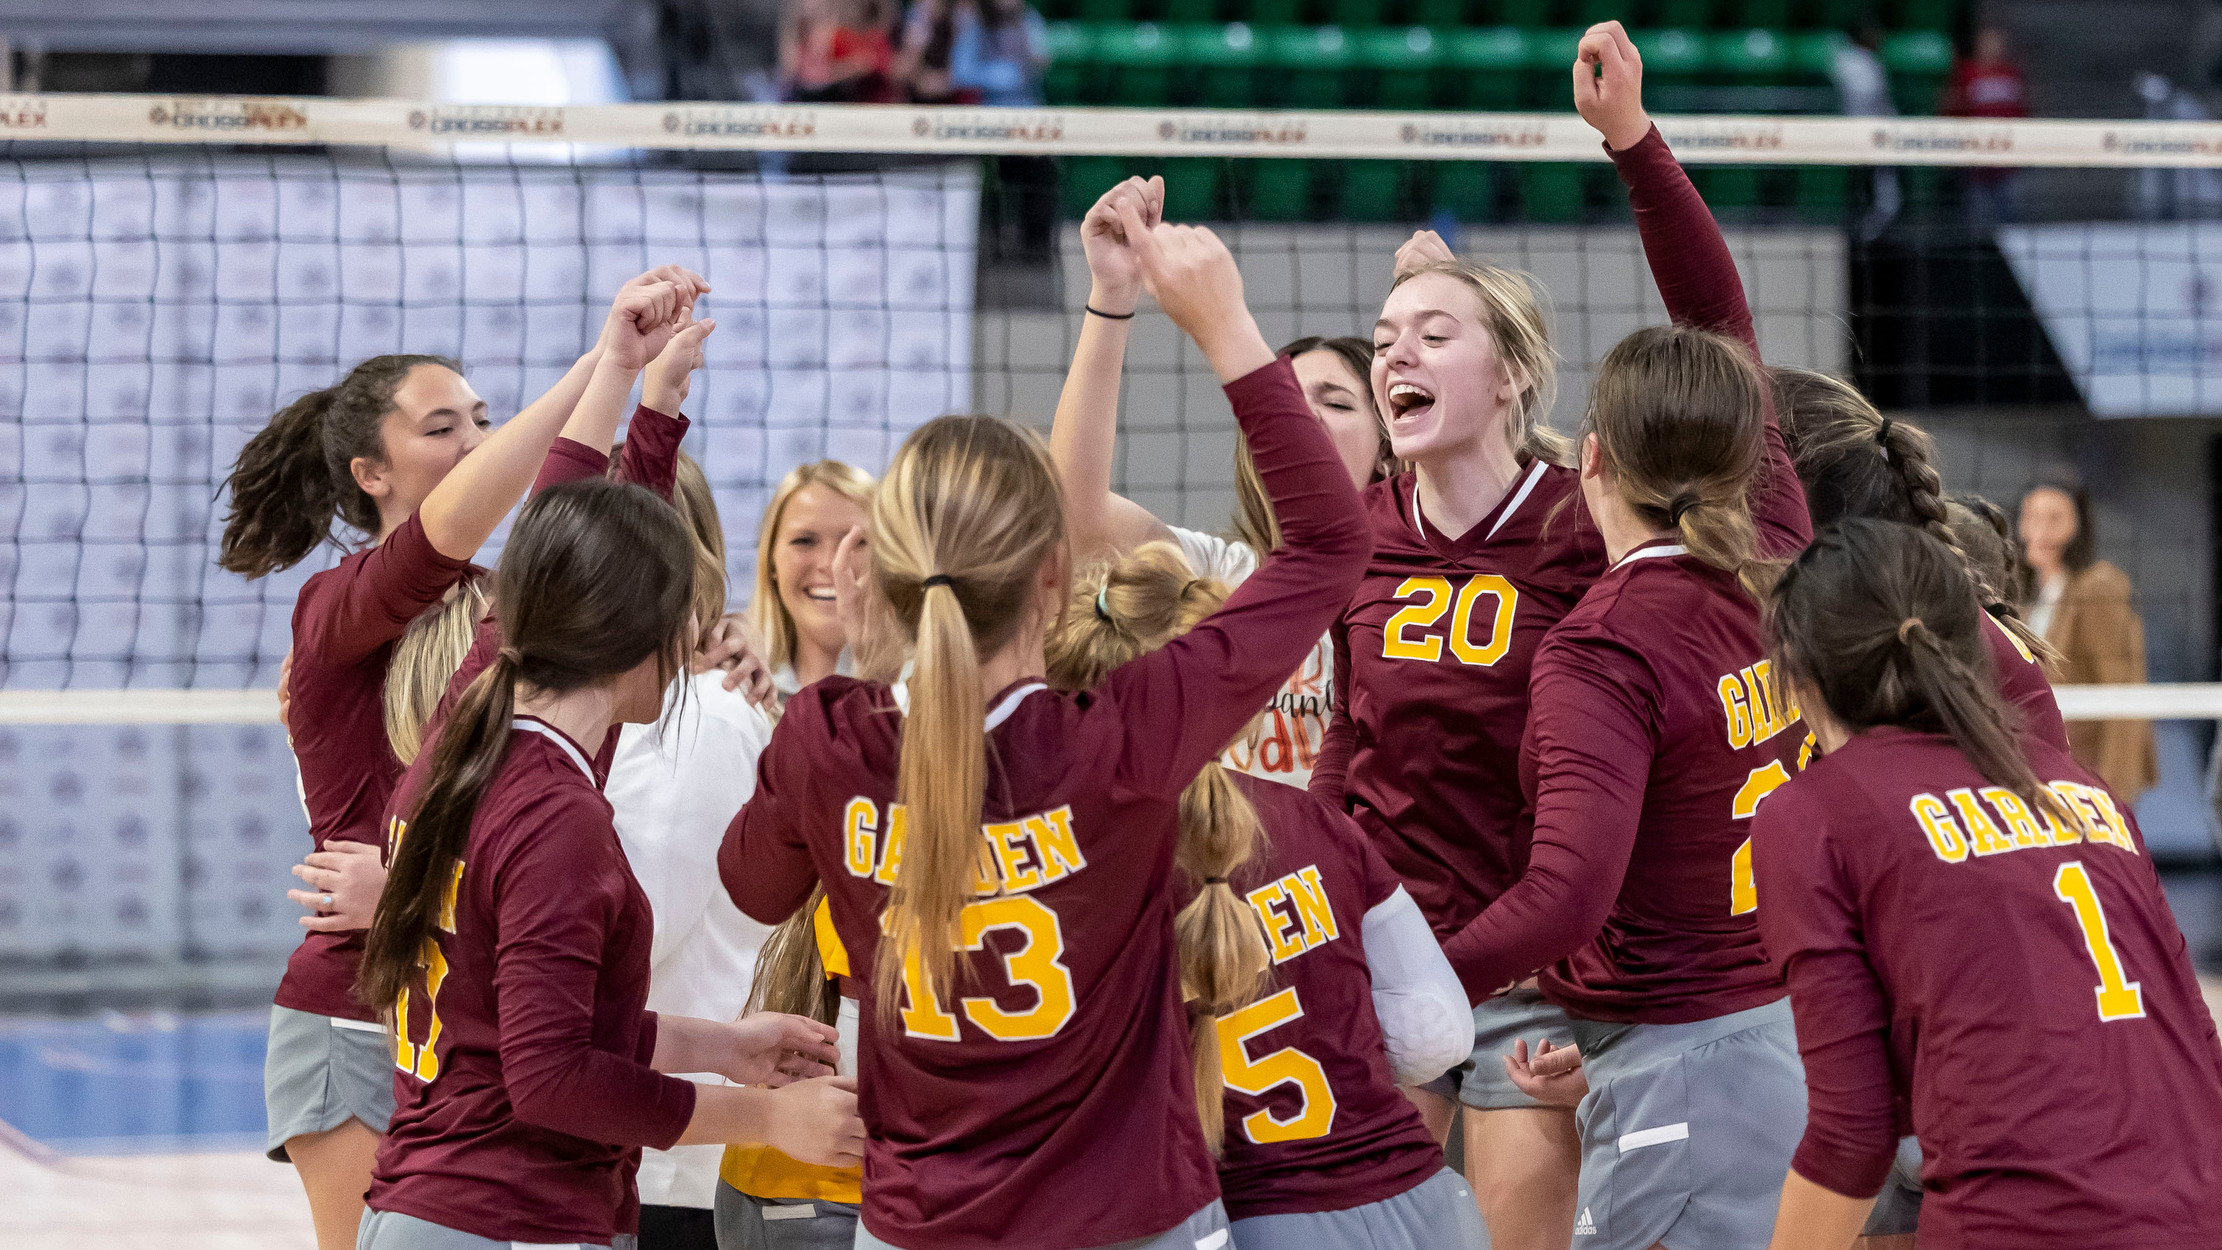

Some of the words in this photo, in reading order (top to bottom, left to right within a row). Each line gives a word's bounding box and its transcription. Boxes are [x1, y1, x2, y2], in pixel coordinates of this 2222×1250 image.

[1382, 574, 1518, 666] 20
[844, 795, 1088, 896] GADEN
[878, 893, 1078, 1042] 13
[2053, 861, 2147, 1022] 1
[1214, 986, 1338, 1145] 5
[1575, 1225, 1597, 1236] adidas
